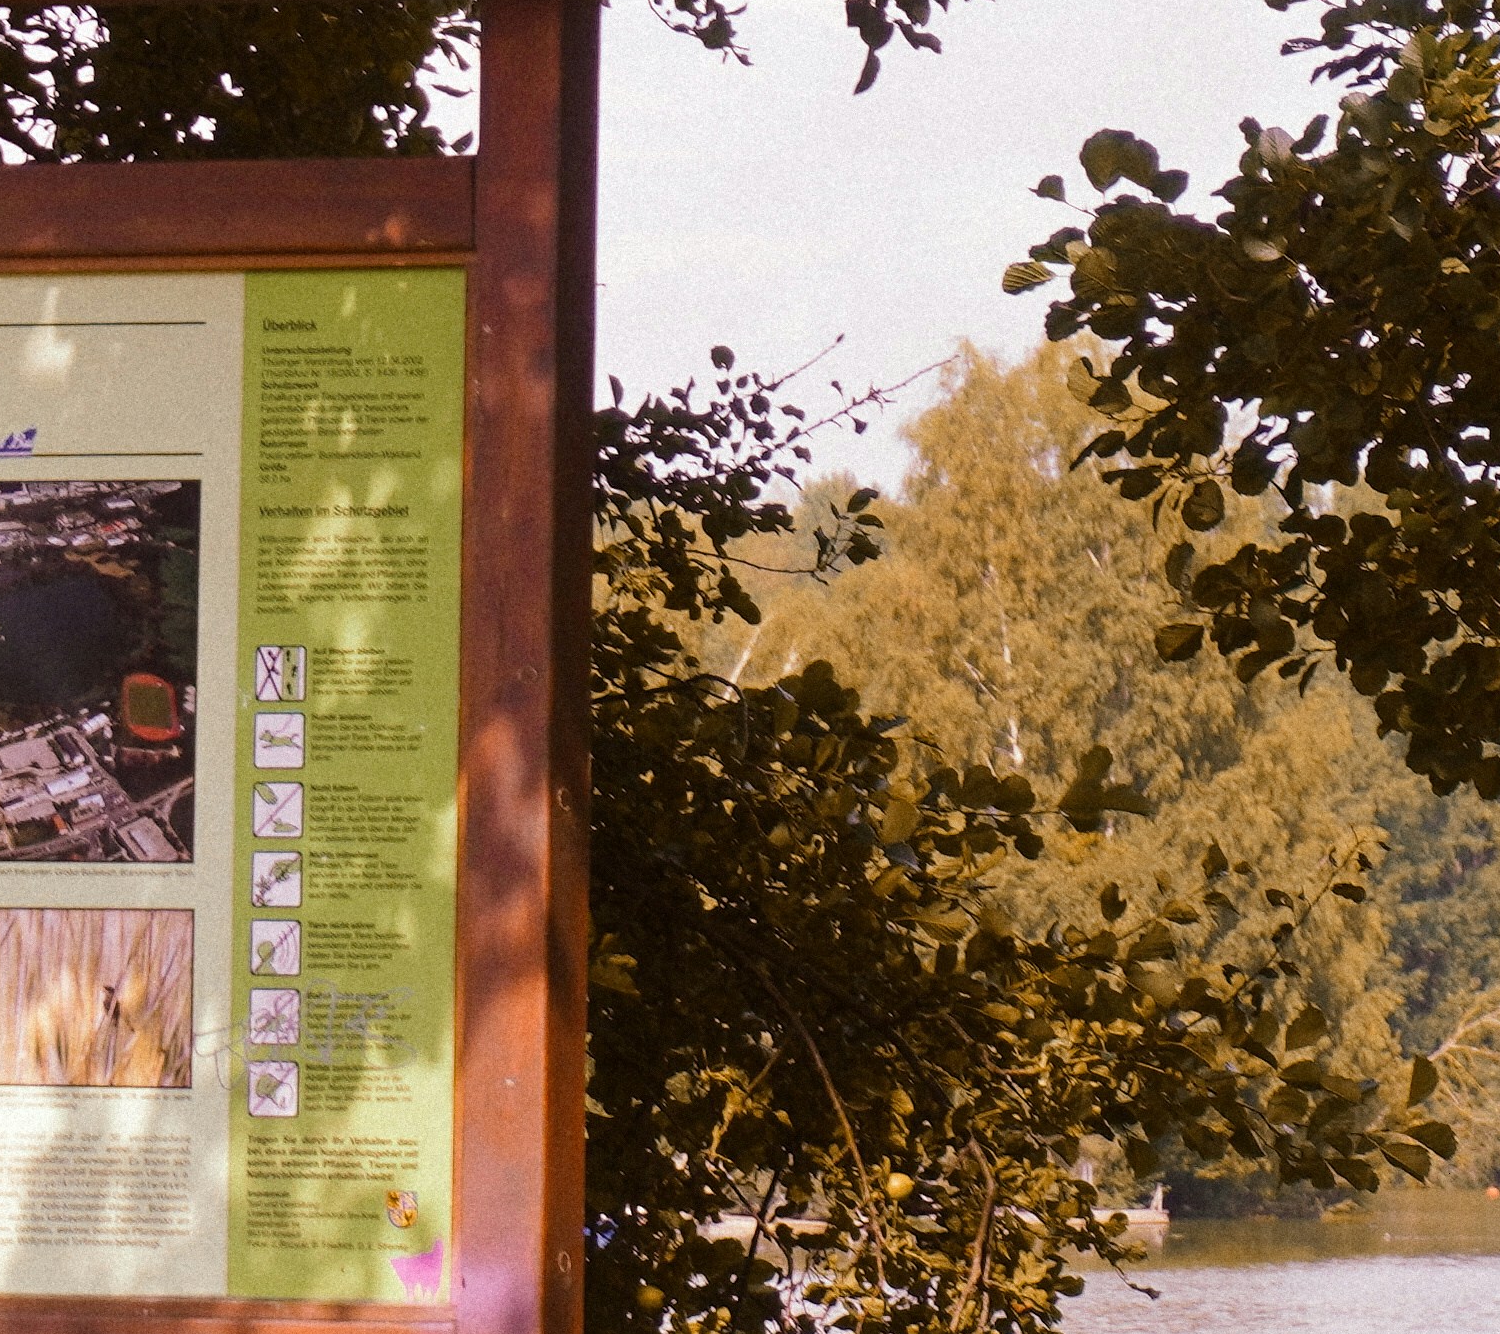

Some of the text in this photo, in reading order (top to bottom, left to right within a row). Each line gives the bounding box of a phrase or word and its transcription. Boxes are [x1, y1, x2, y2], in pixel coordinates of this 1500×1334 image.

[259, 505, 409, 519] Verhalten im Schutzgebiet
